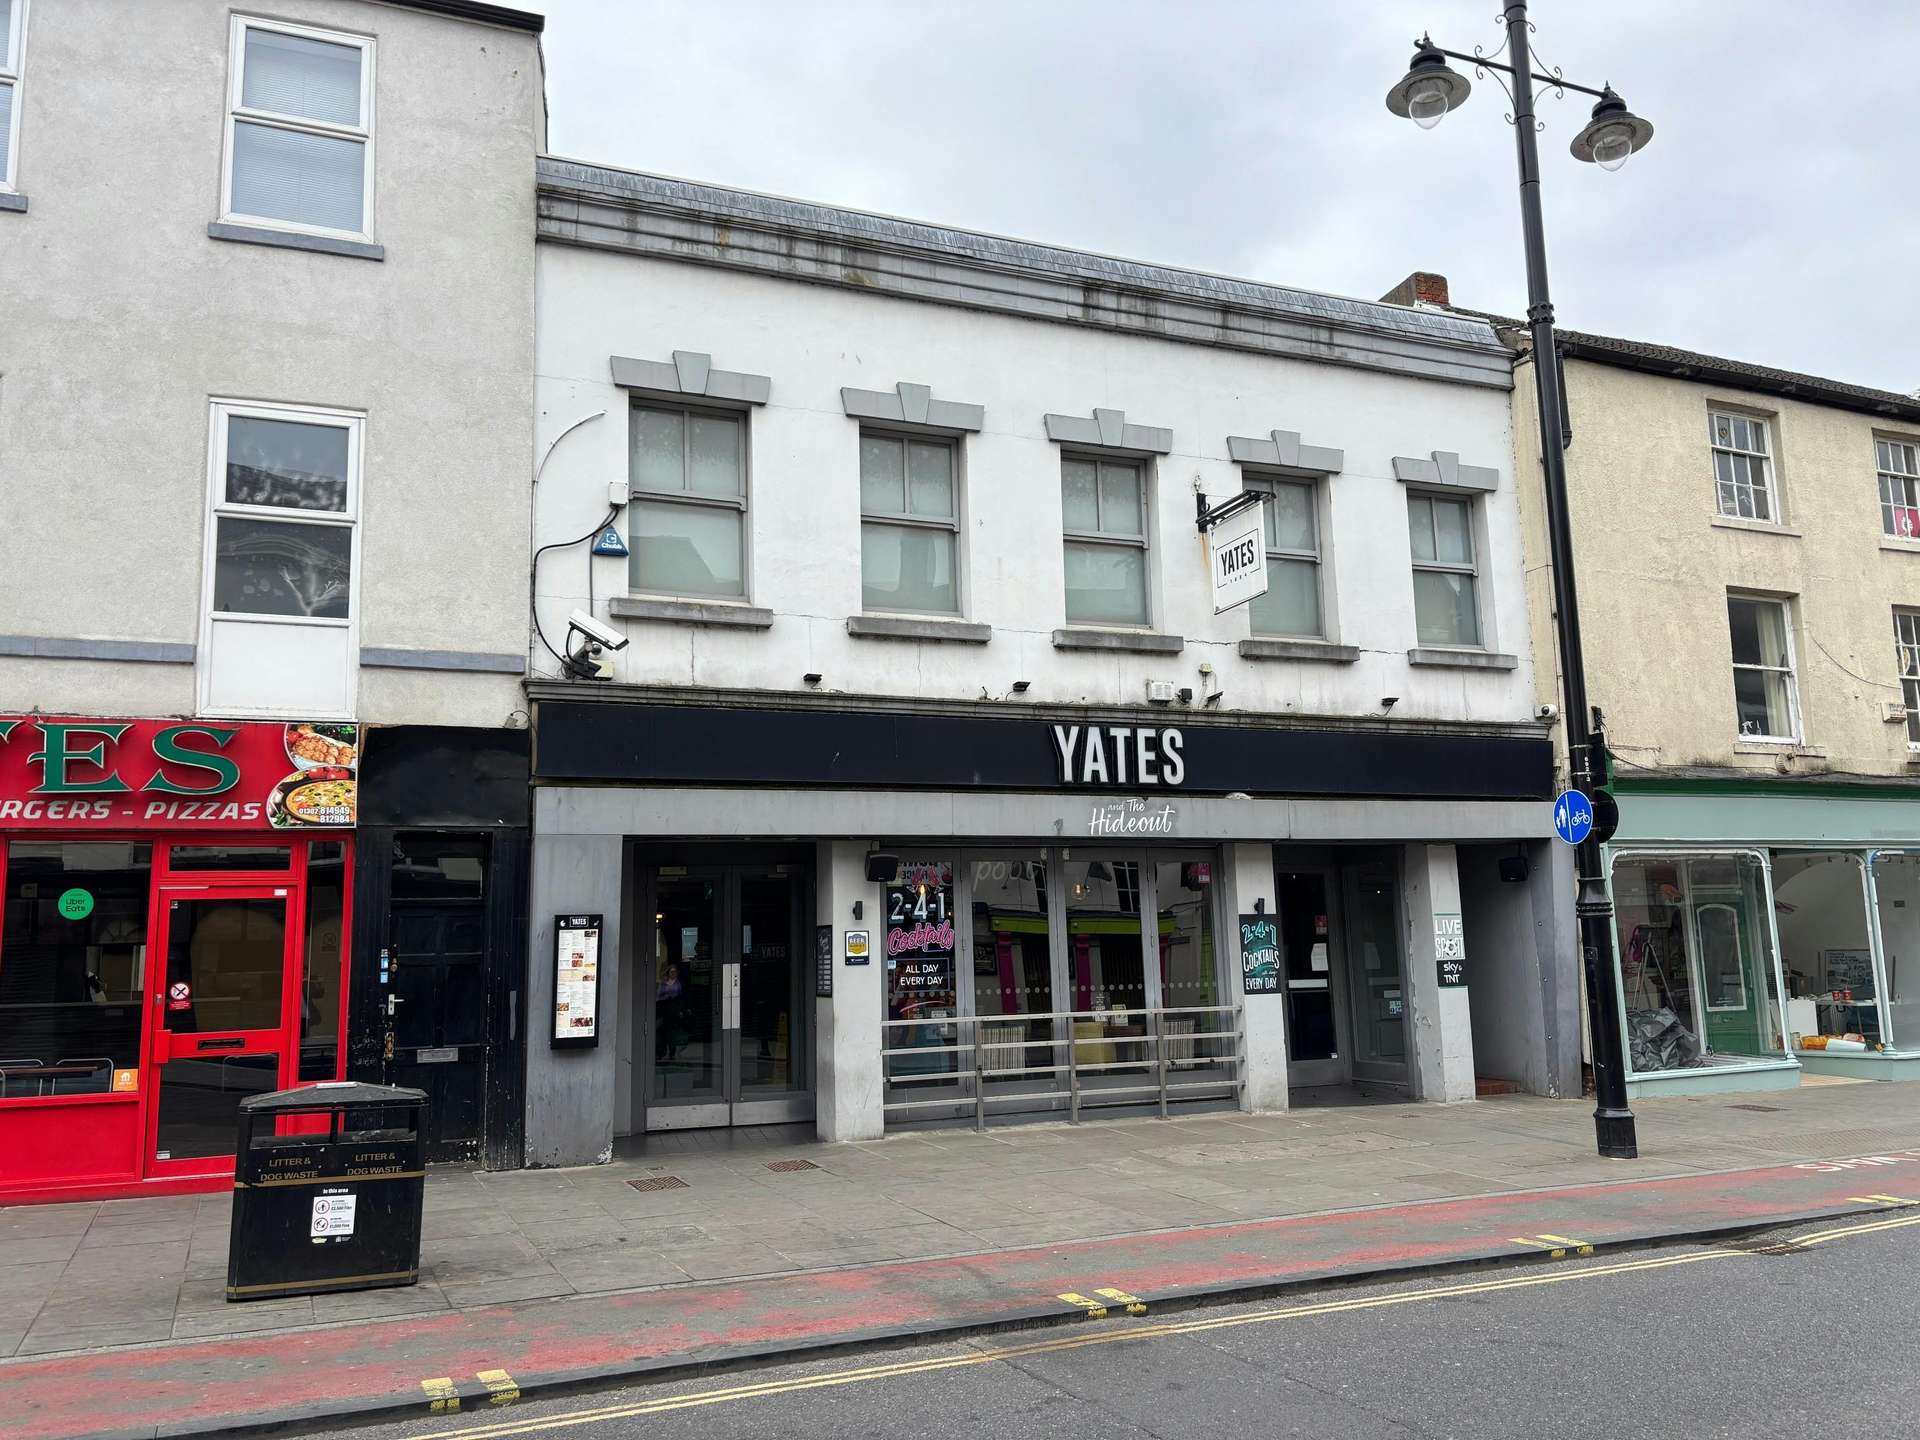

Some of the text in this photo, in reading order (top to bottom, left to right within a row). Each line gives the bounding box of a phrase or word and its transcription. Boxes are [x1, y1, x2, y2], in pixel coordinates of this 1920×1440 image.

[1221, 539, 1254, 577] YATES
[1052, 724, 1185, 785] YATES
[0, 799, 113, 819] RGERS
[144, 802, 262, 820] PIZZAS
[1126, 798, 1146, 812] The
[1087, 805, 1176, 835] Hideout
[889, 892, 945, 923] 2-4-1
[1241, 920, 1277, 946] 2-4-1
[1434, 919, 1462, 935] LIVE
[887, 919, 955, 956] Cocktails
[905, 965, 920, 973] ALL
[922, 964, 939, 973] DAY
[1443, 961, 1458, 974] sky
[900, 976, 944, 986] EVERY DAY
[1245, 977, 1277, 990] EVERY DAY
[1443, 974, 1460, 983] TNT
[269, 1158, 302, 1167] LITTER
[355, 1152, 396, 1162] LITTER &
[260, 1170, 319, 1182] DOG WASTE
[347, 1165, 403, 1176] DOG WASTE
